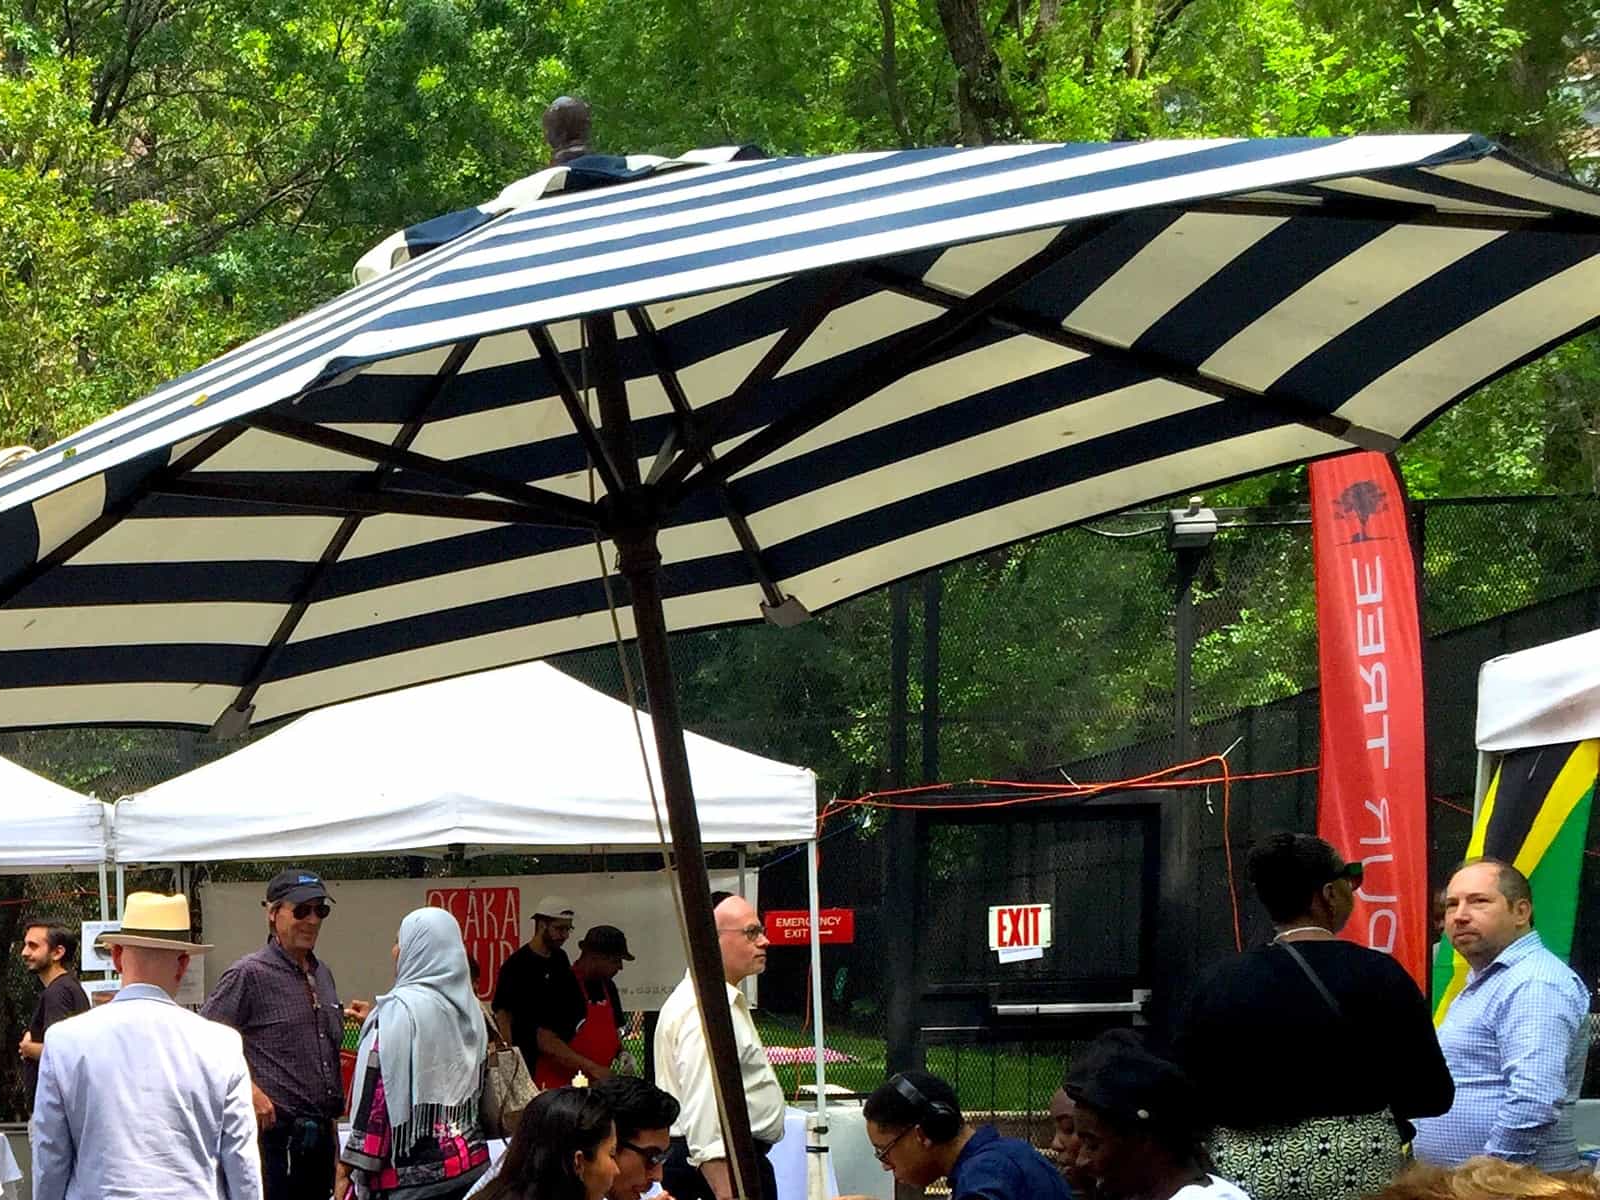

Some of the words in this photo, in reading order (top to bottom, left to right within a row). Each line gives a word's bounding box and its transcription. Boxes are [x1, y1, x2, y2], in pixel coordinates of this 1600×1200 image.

[775, 916, 842, 927] EMERNCY
[997, 907, 1041, 947] EXIT
[784, 928, 809, 938] EXIT
